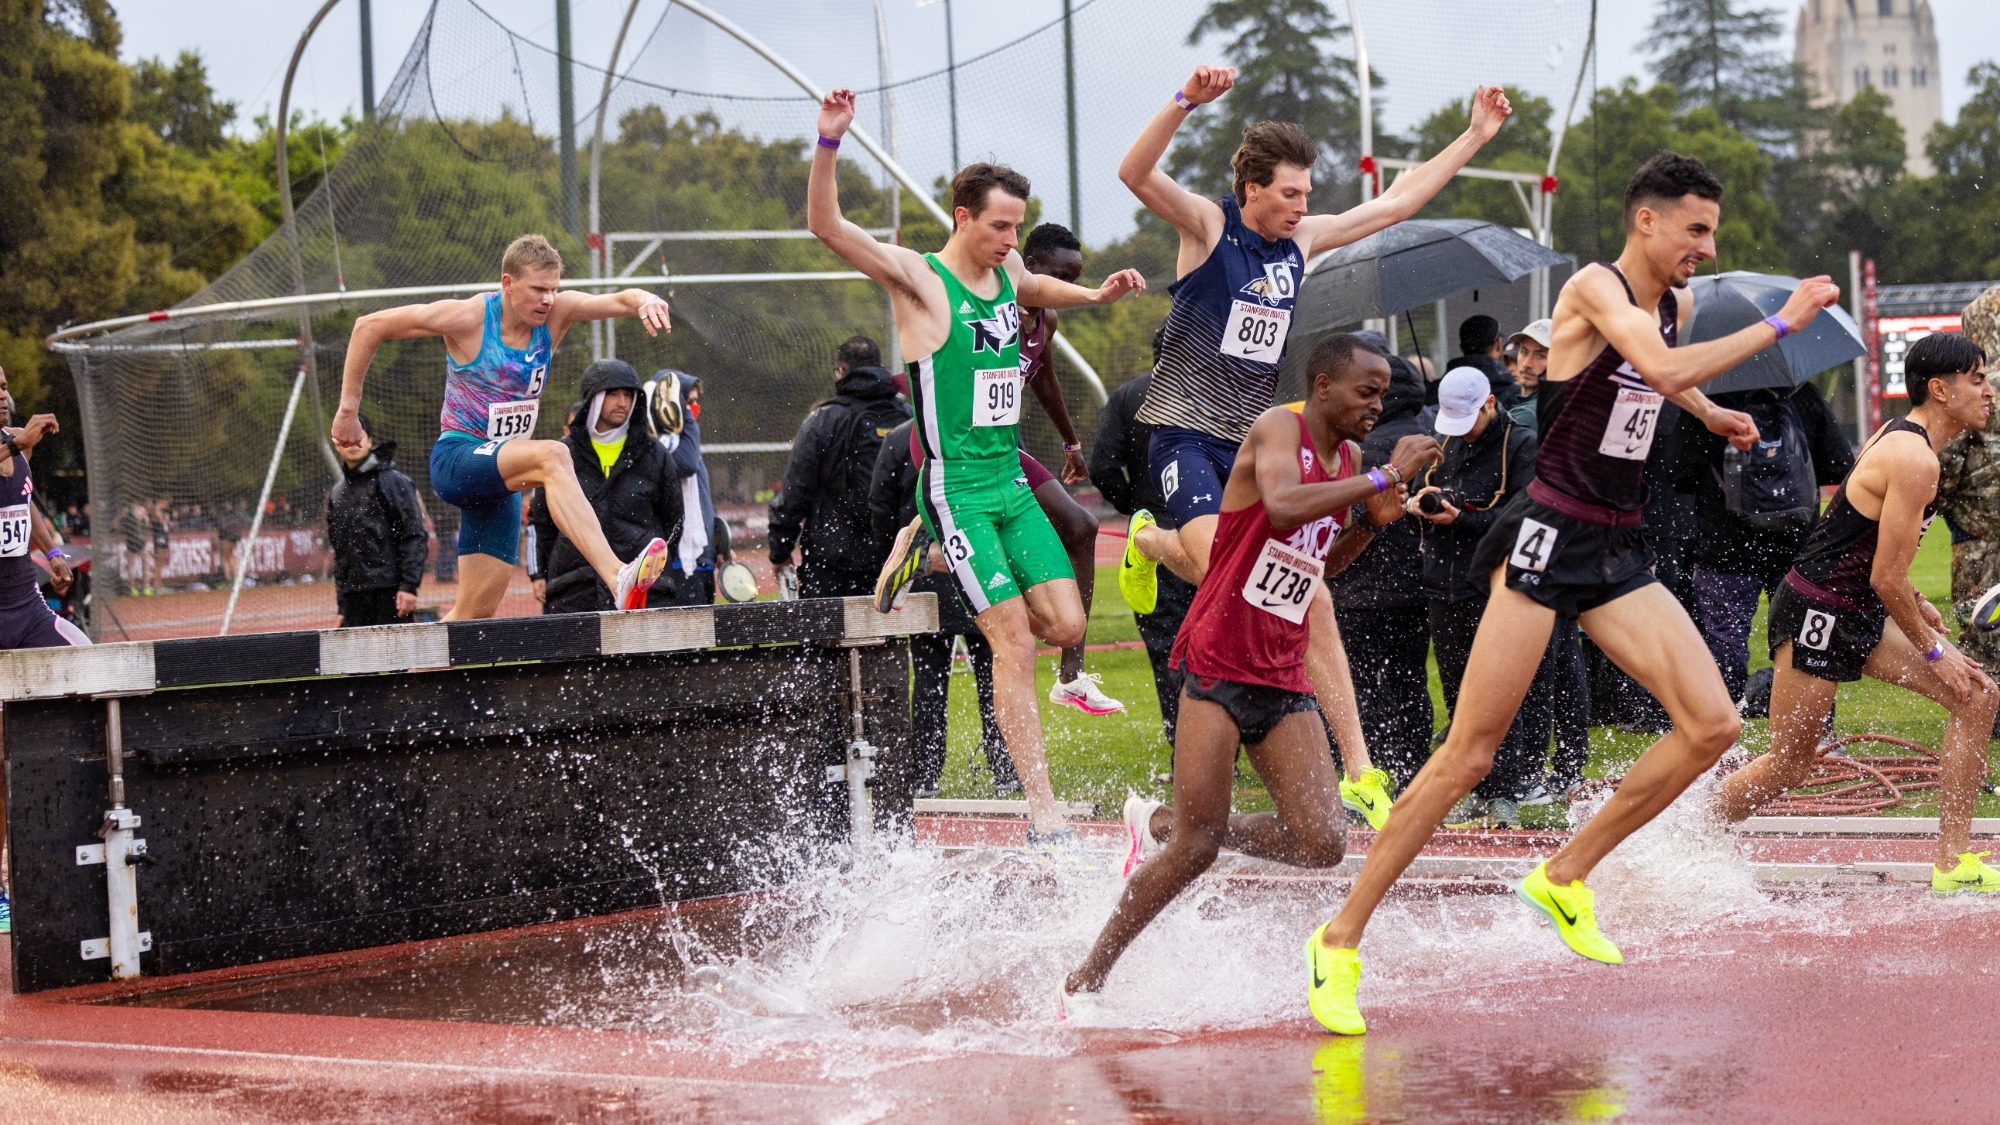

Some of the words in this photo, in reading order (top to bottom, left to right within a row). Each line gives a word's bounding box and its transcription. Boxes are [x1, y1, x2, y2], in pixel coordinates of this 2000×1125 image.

[1272, 264, 1290, 296] 6
[997, 302, 1018, 332] 13
[1240, 303, 1270, 317] STANFORD
[1238, 316, 1278, 347] 803
[530, 367, 545, 395] 5
[982, 370, 1007, 380] STANFORD
[493, 406, 513, 416] STANFORD
[988, 381, 1014, 410] 919
[493, 413, 532, 438] 1539
[1623, 408, 1657, 441] 457
[1163, 465, 1175, 496] 6
[0, 519, 27, 546] 547
[1518, 526, 1548, 569] 4
[943, 535, 968, 568] 13
[1267, 546, 1295, 565] STANFORD
[1291, 558, 1321, 577] INVITATIONAL
[1255, 561, 1312, 605] 1738
[1805, 613, 1828, 647] 8
